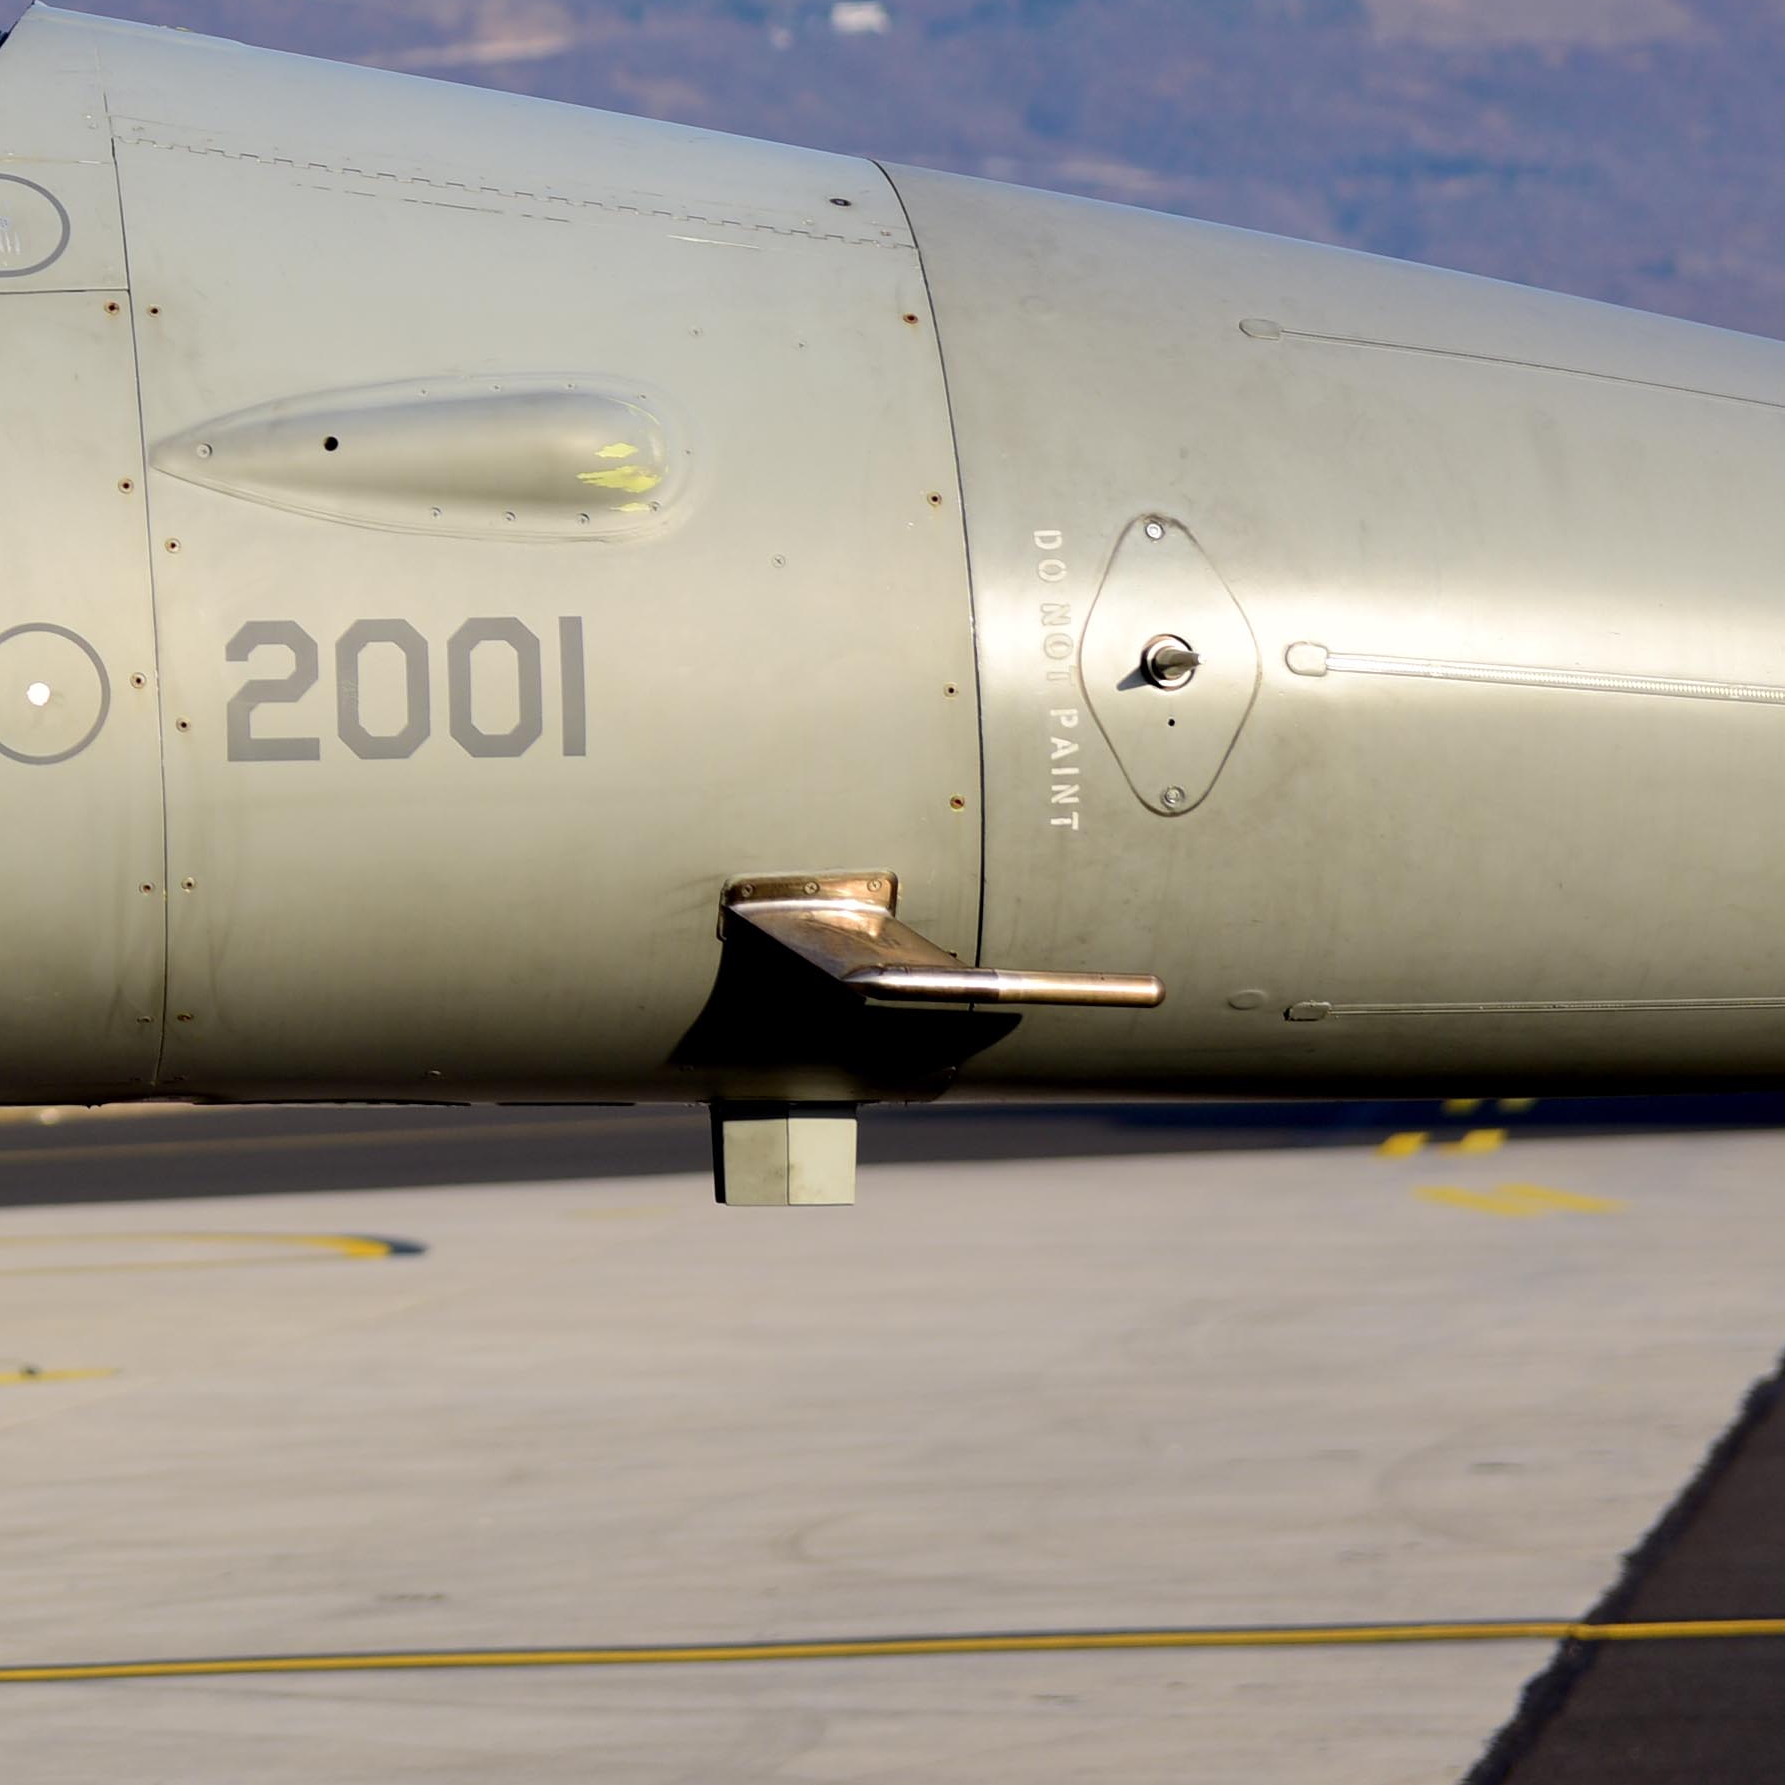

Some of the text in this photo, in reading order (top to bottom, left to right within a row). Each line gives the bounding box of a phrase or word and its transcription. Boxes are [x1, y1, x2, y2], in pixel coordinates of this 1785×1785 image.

[225, 615, 587, 763] 2001
[1033, 529, 1080, 832] DO NOT PAINT
